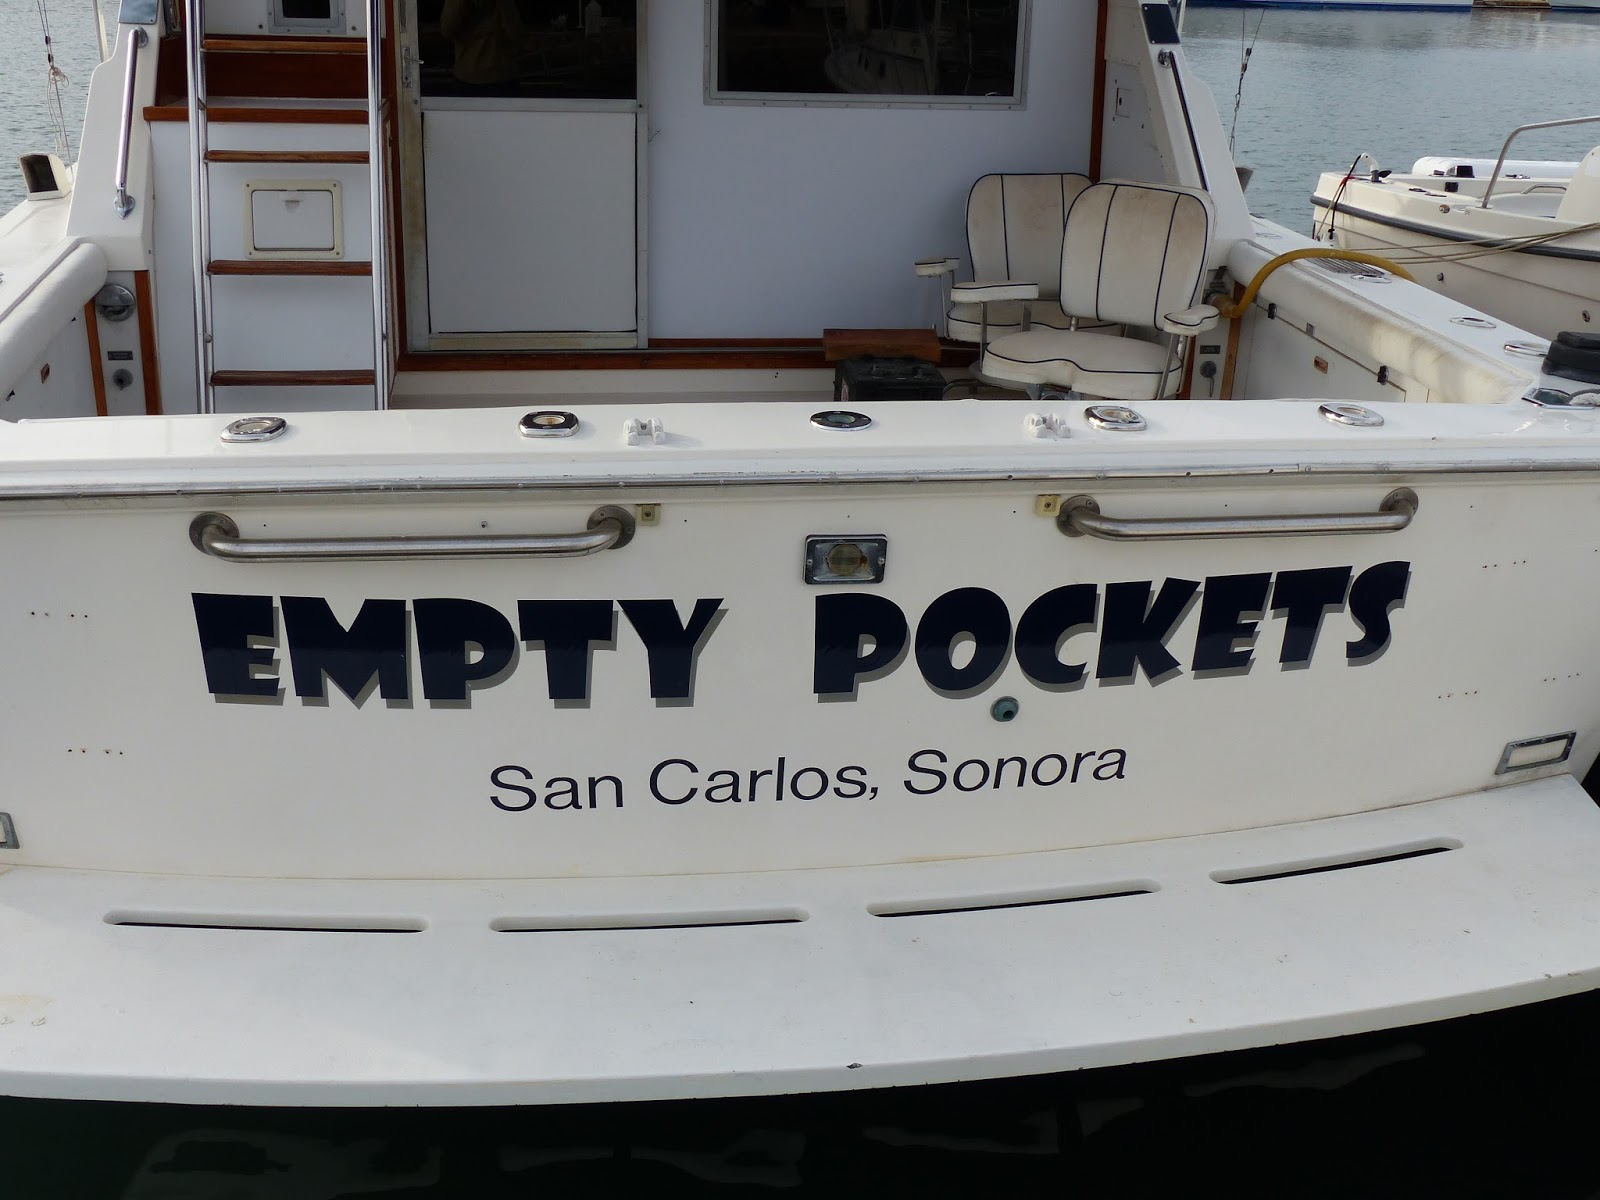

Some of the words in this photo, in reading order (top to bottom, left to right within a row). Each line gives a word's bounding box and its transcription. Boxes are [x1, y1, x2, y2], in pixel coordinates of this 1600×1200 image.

[190, 592, 729, 710] EMPTY
[813, 561, 1412, 704] POCKETS
[490, 764, 624, 812] San
[649, 756, 879, 806] Carlos,
[903, 748, 1127, 795] Sonora
